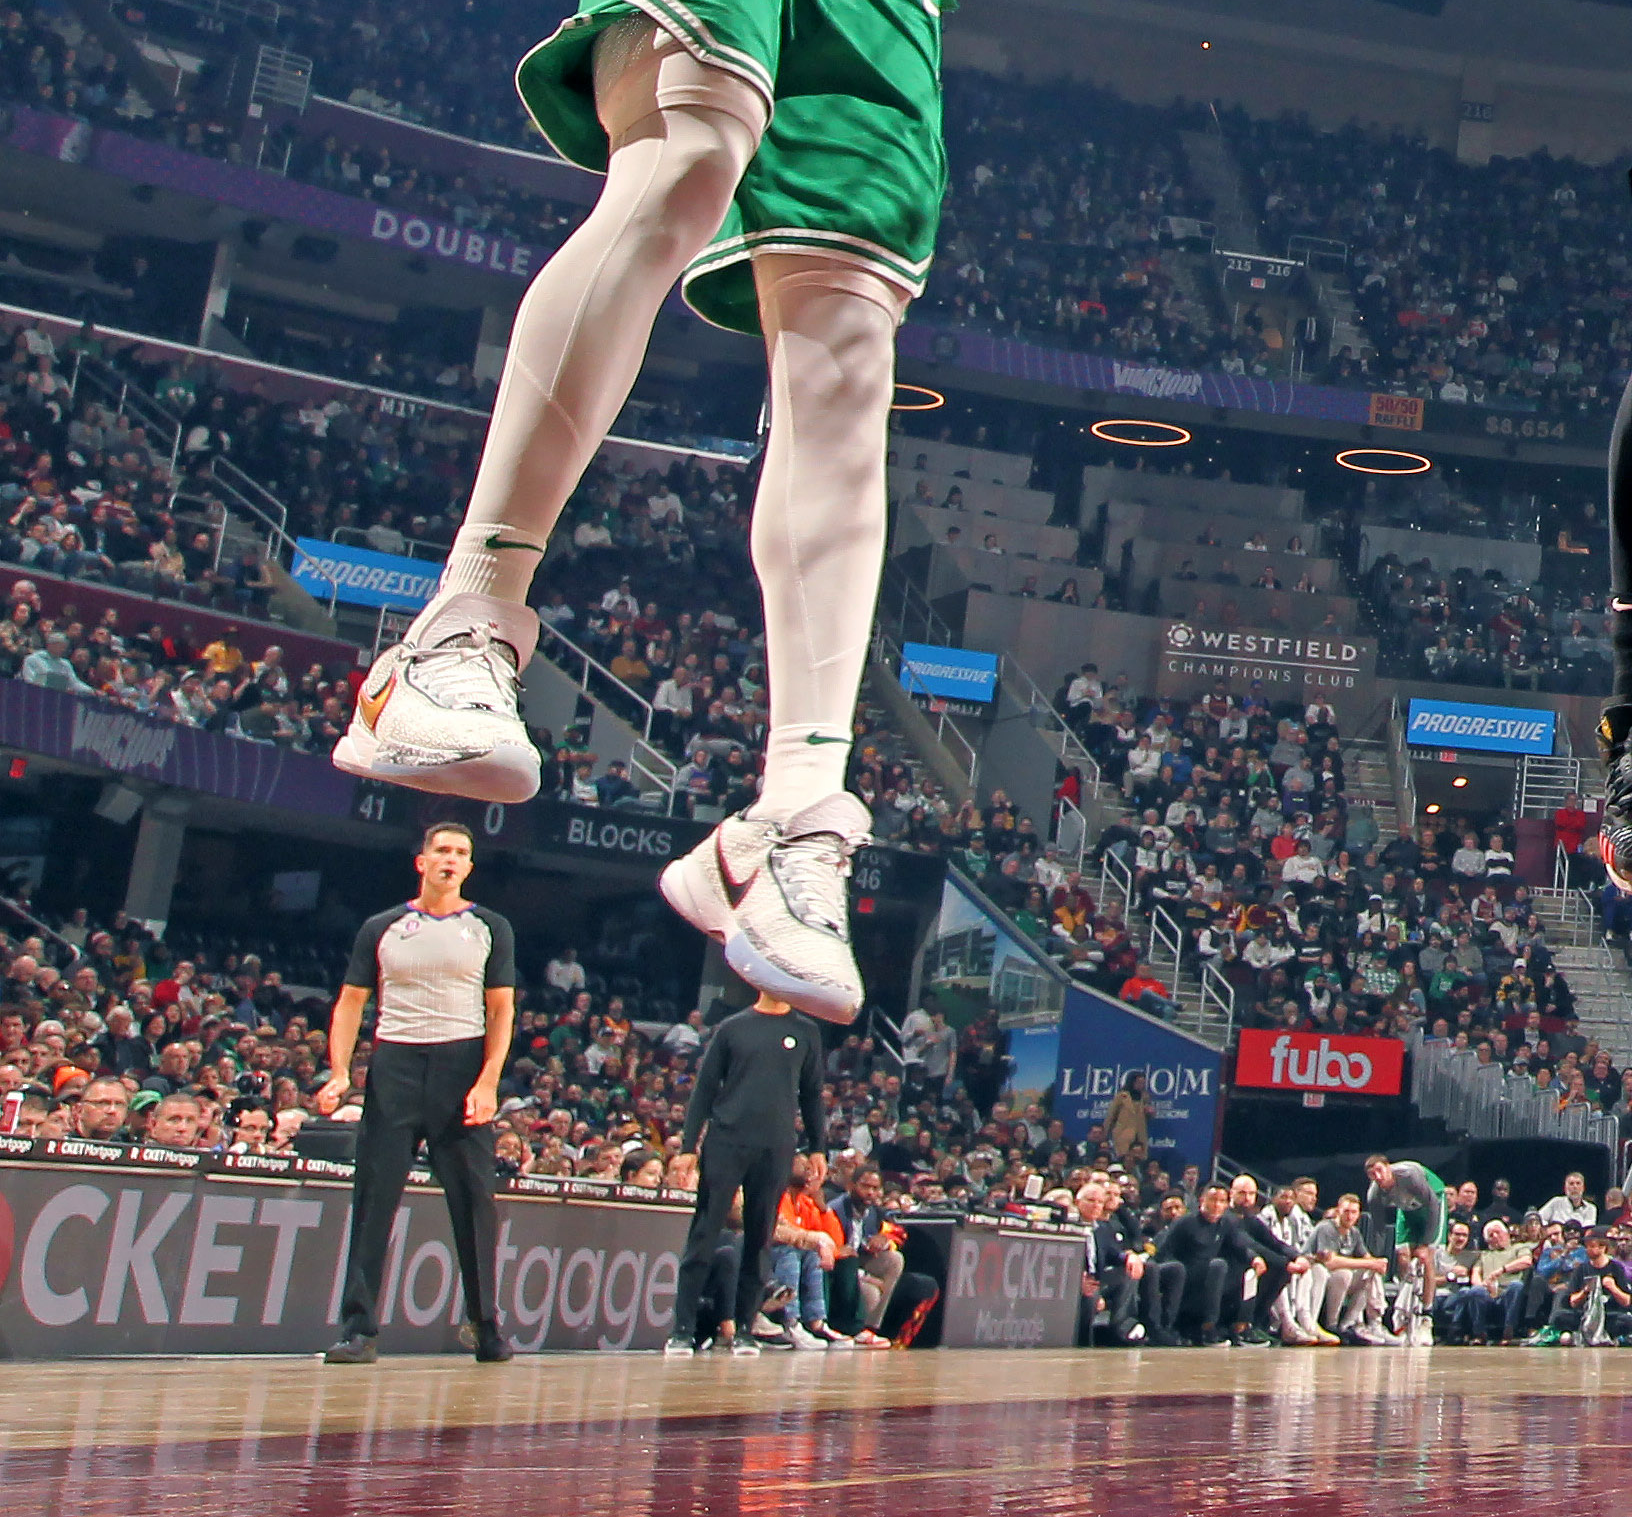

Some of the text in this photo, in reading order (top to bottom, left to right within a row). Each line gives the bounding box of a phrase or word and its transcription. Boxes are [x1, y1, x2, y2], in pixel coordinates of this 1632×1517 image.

[371, 207, 532, 277] DOUBLE
[1376, 396, 1419, 415] 50/50
[1485, 415, 1566, 440] $8,654
[1200, 630, 1358, 662] WESTFIELD
[1168, 660, 1355, 689] CHAMPIONS CLUB
[1411, 711, 1548, 742] PROGRESSIVE
[359, 794, 386, 822] 41
[483, 802, 505, 836] 0
[566, 817, 673, 856] BLOCKS
[855, 867, 881, 891] 46
[1270, 1034, 1373, 1089] fubo
[956, 1238, 1076, 1299] ROCKET
[975, 1307, 1046, 1346] Mortgage
